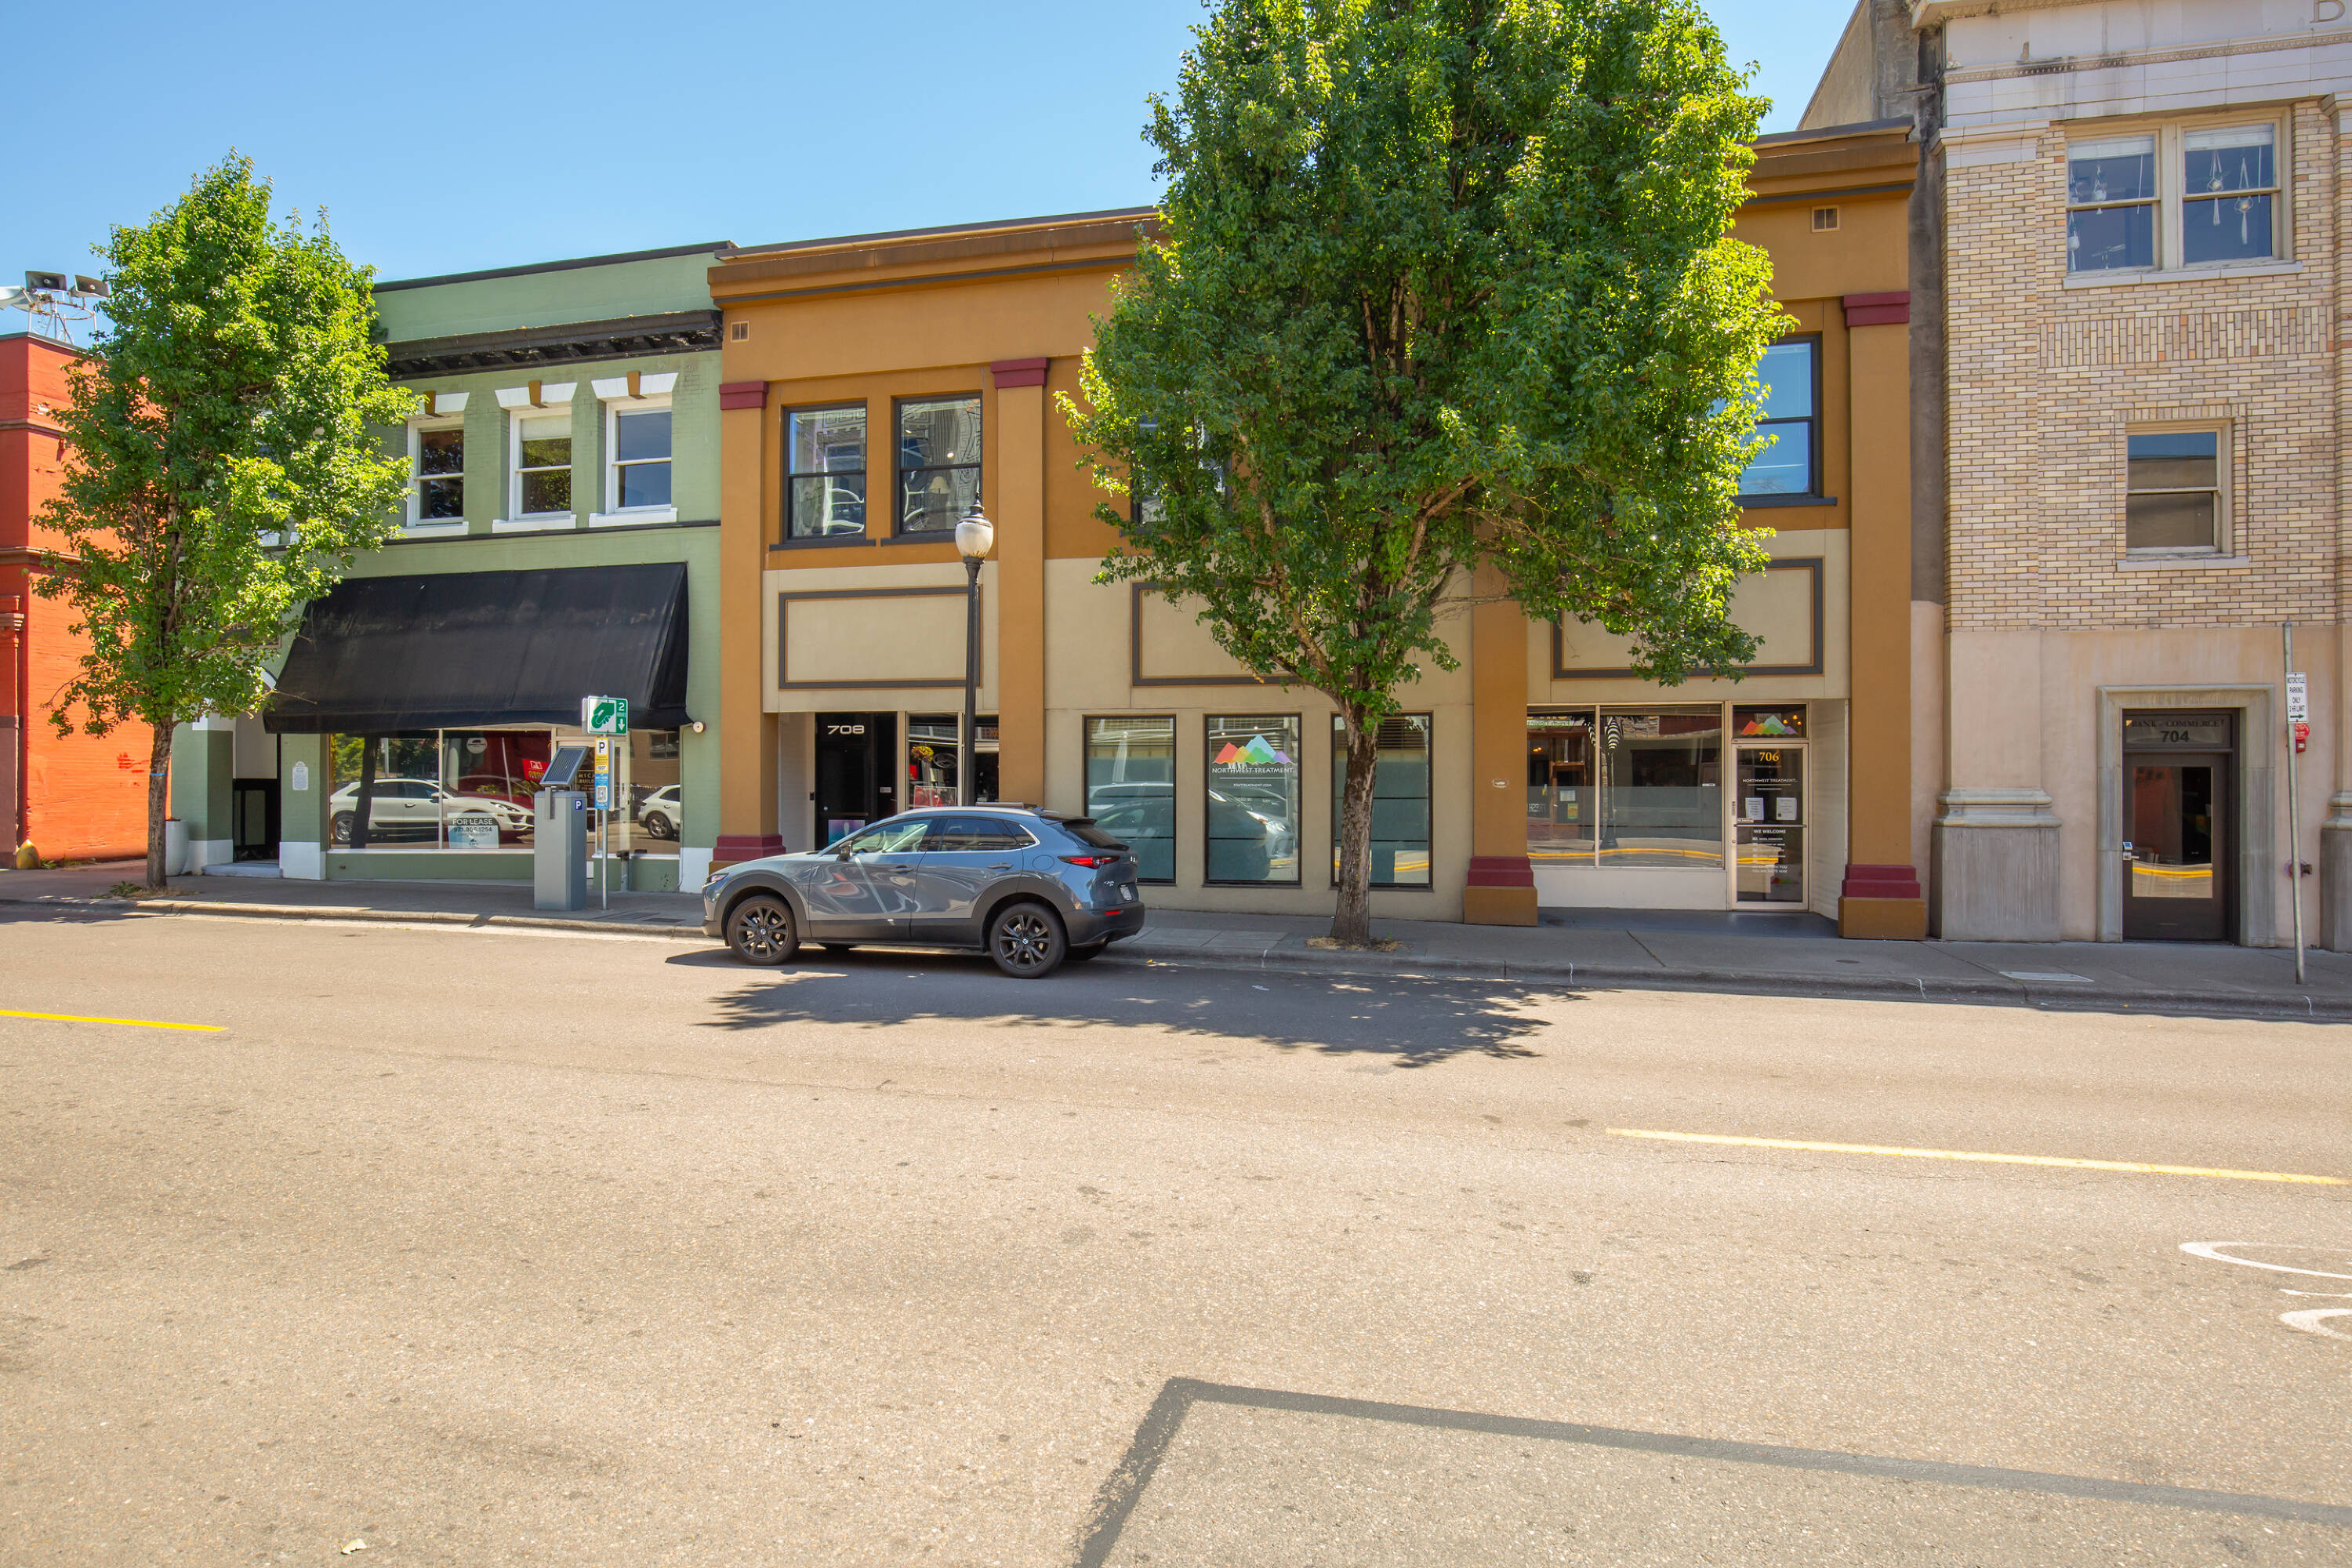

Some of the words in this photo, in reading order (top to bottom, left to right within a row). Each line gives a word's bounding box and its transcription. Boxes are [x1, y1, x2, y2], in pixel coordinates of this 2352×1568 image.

[619, 702, 625, 711] 2
[827, 725, 865, 735] 708
[2161, 731, 2190, 742] 704
[599, 742, 605, 753] P
[1759, 752, 1780, 761] 706
[576, 800, 582, 810] P
